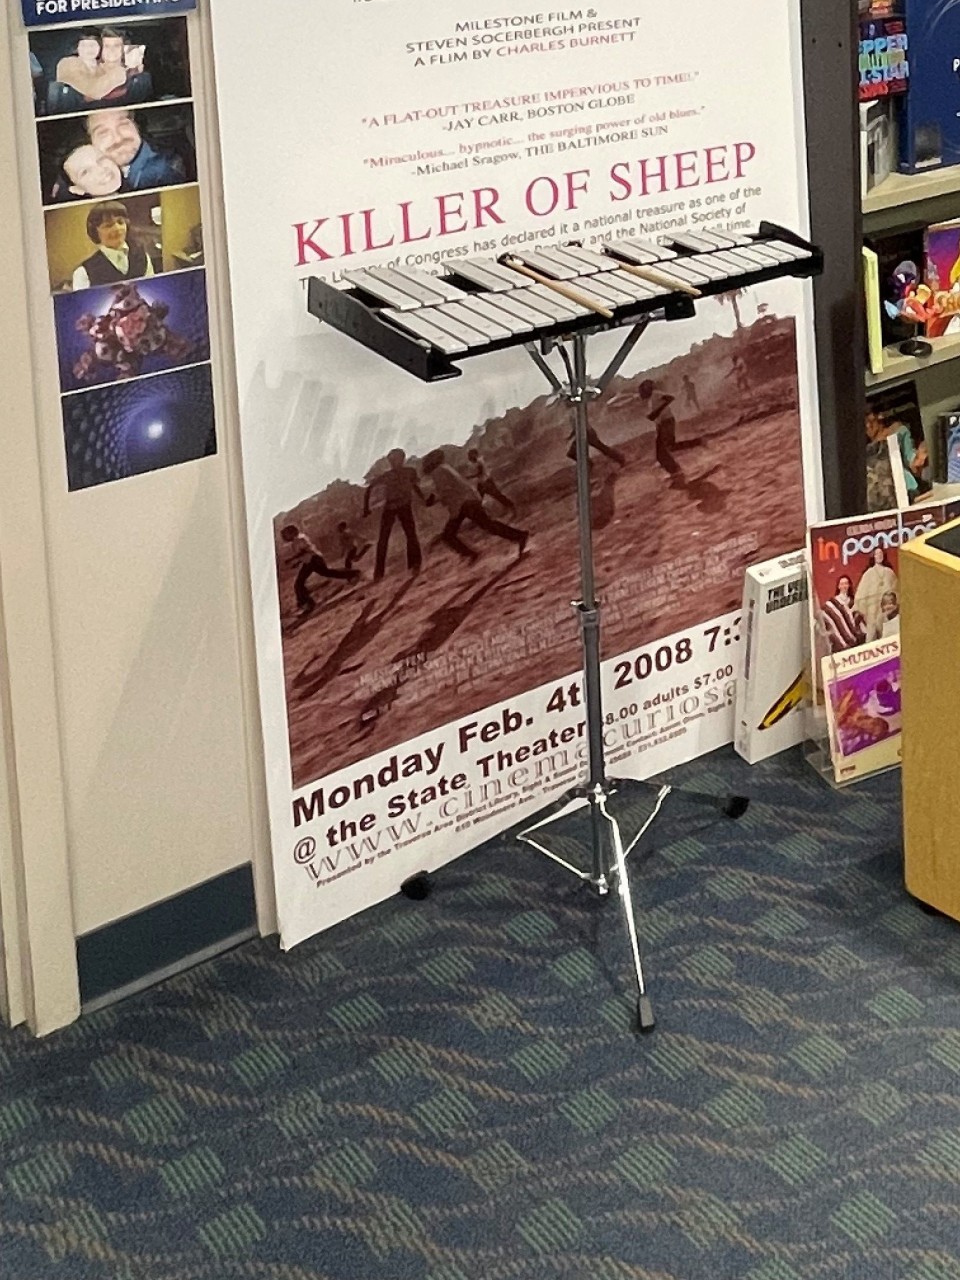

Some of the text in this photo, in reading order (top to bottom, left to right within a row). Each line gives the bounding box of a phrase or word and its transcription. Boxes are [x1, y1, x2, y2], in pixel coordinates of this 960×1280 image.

[405, 17, 641, 54] STEVEN SOCERBERGH PRESENT
[455, 8, 598, 32] MILESTONE FILM &
[413, 31, 636, 68] A FLIM BY CHARLES BURNETT
[384, 104, 459, 126] FLAT-OUT
[464, 93, 541, 114] TREASURE
[544, 80, 631, 101] IMPERVIOUS
[634, 77, 652, 89] TO
[442, 93, 637, 133] -JAY CARR, BOSTON GLOBE
[527, 129, 546, 143] the
[549, 123, 593, 142] surging
[596, 117, 631, 135] power
[634, 114, 646, 126] of
[648, 111, 666, 124] old
[411, 125, 669, 177] -Michael Sragow, THE BALTIMORE SUN
[292, 142, 757, 267] KILLER OF SHEEP
[405, 244, 469, 267] Congress
[473, 238, 496, 252] has
[501, 222, 555, 247] declared
[559, 222, 568, 236] it
[572, 222, 580, 233] a
[584, 208, 632, 230] national
[636, 201, 685, 219] treasure
[688, 197, 702, 210] as
[705, 192, 726, 207] one
[729, 187, 741, 202] of
[743, 184, 762, 198] the
[589, 230, 612, 246] and
[616, 225, 636, 241] the
[640, 213, 688, 235] National
[691, 207, 732, 225] Society
[735, 202, 746, 215] of
[817, 537, 839, 561] in
[768, 586, 785, 600] THE
[292, 741, 446, 827] Monday
[458, 708, 534, 753] Feb.
[546, 681, 582, 715] 4t
[613, 637, 692, 690] 2008
[293, 835, 316, 864] @
[326, 812, 376, 847] the
[388, 772, 467, 818] State
[476, 719, 587, 777] Theater
[642, 683, 689, 711] adults
[694, 664, 733, 690] $7.00
